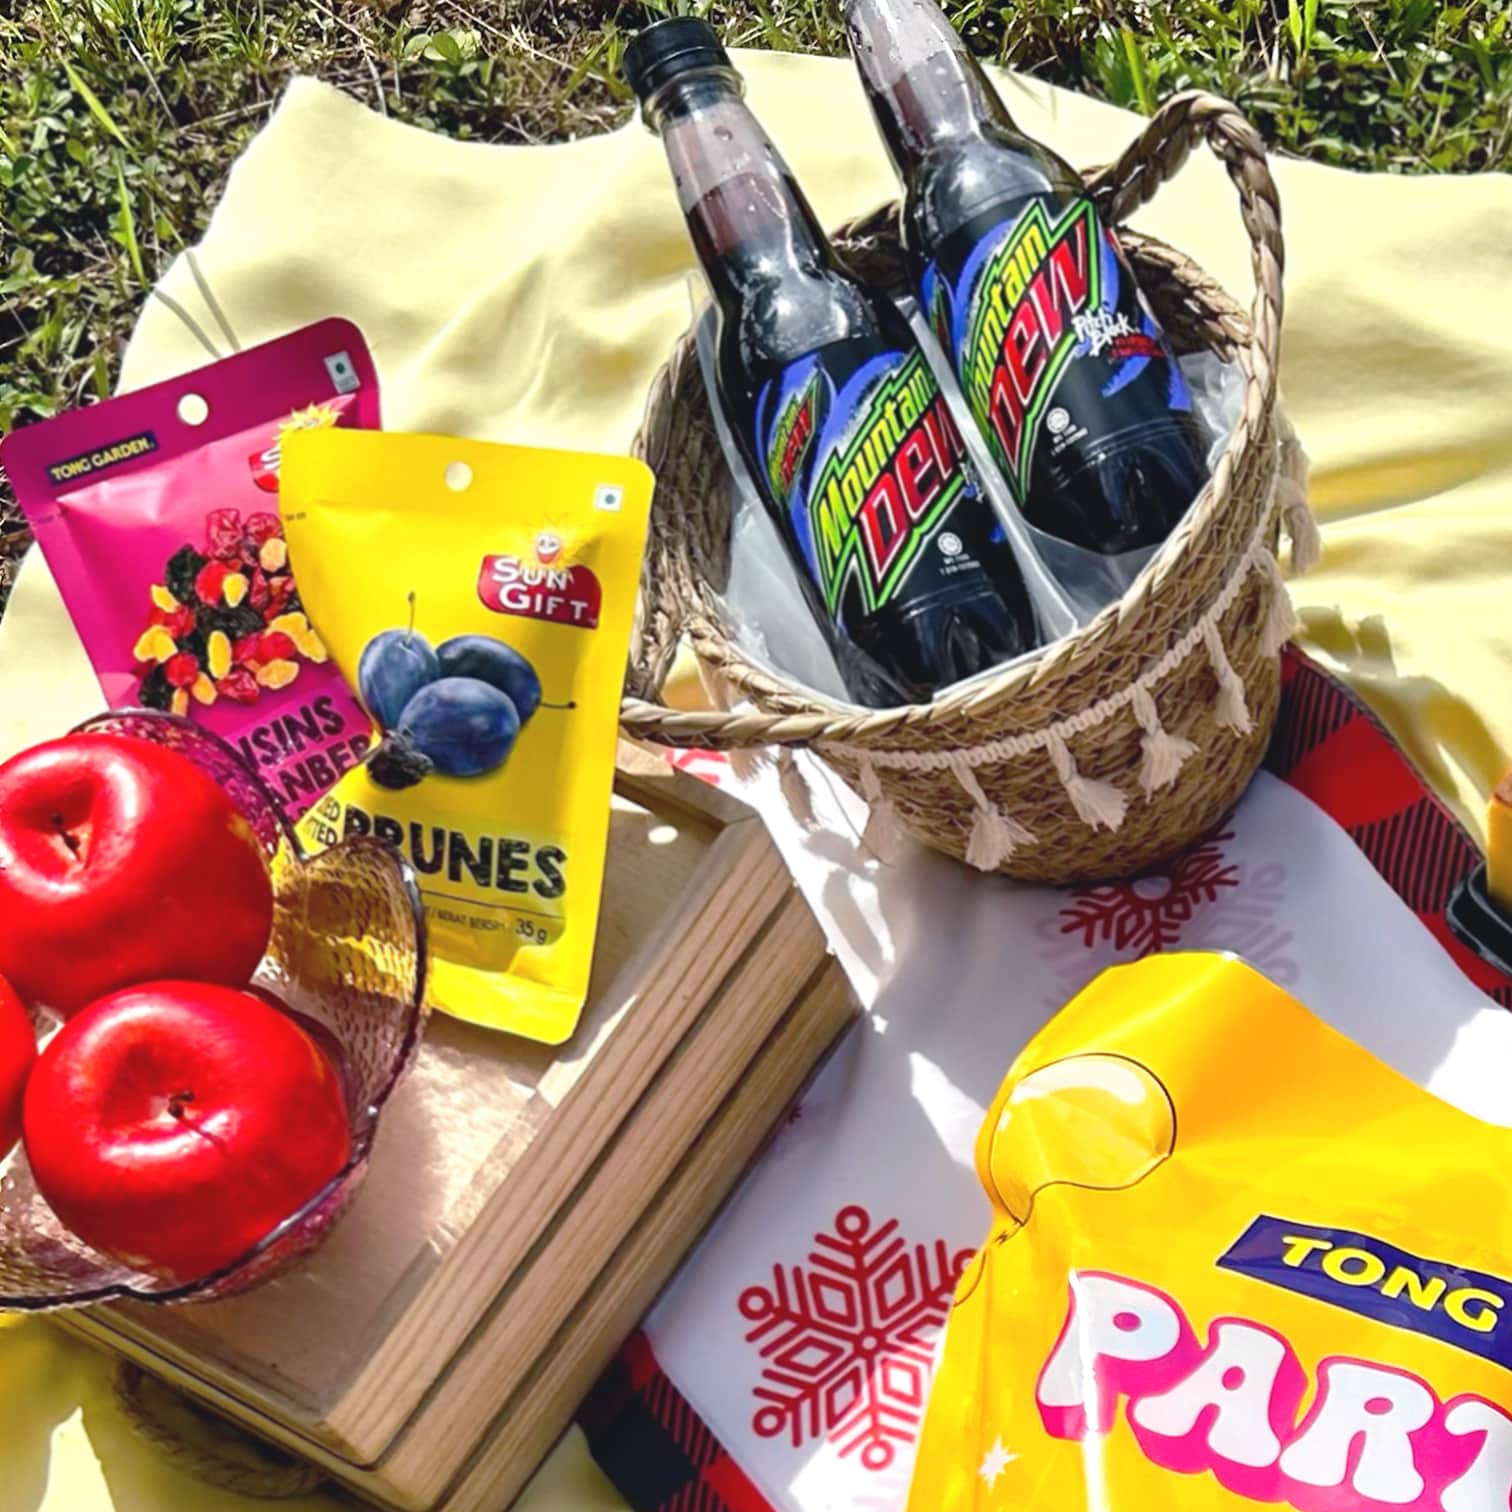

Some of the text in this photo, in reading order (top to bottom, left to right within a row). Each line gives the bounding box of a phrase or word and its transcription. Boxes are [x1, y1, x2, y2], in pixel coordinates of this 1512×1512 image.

[491, 557, 568, 592] SUN
[499, 582, 589, 621] GIFT
[515, 917, 535, 937] 35
[1282, 1235, 1505, 1333] TONG
